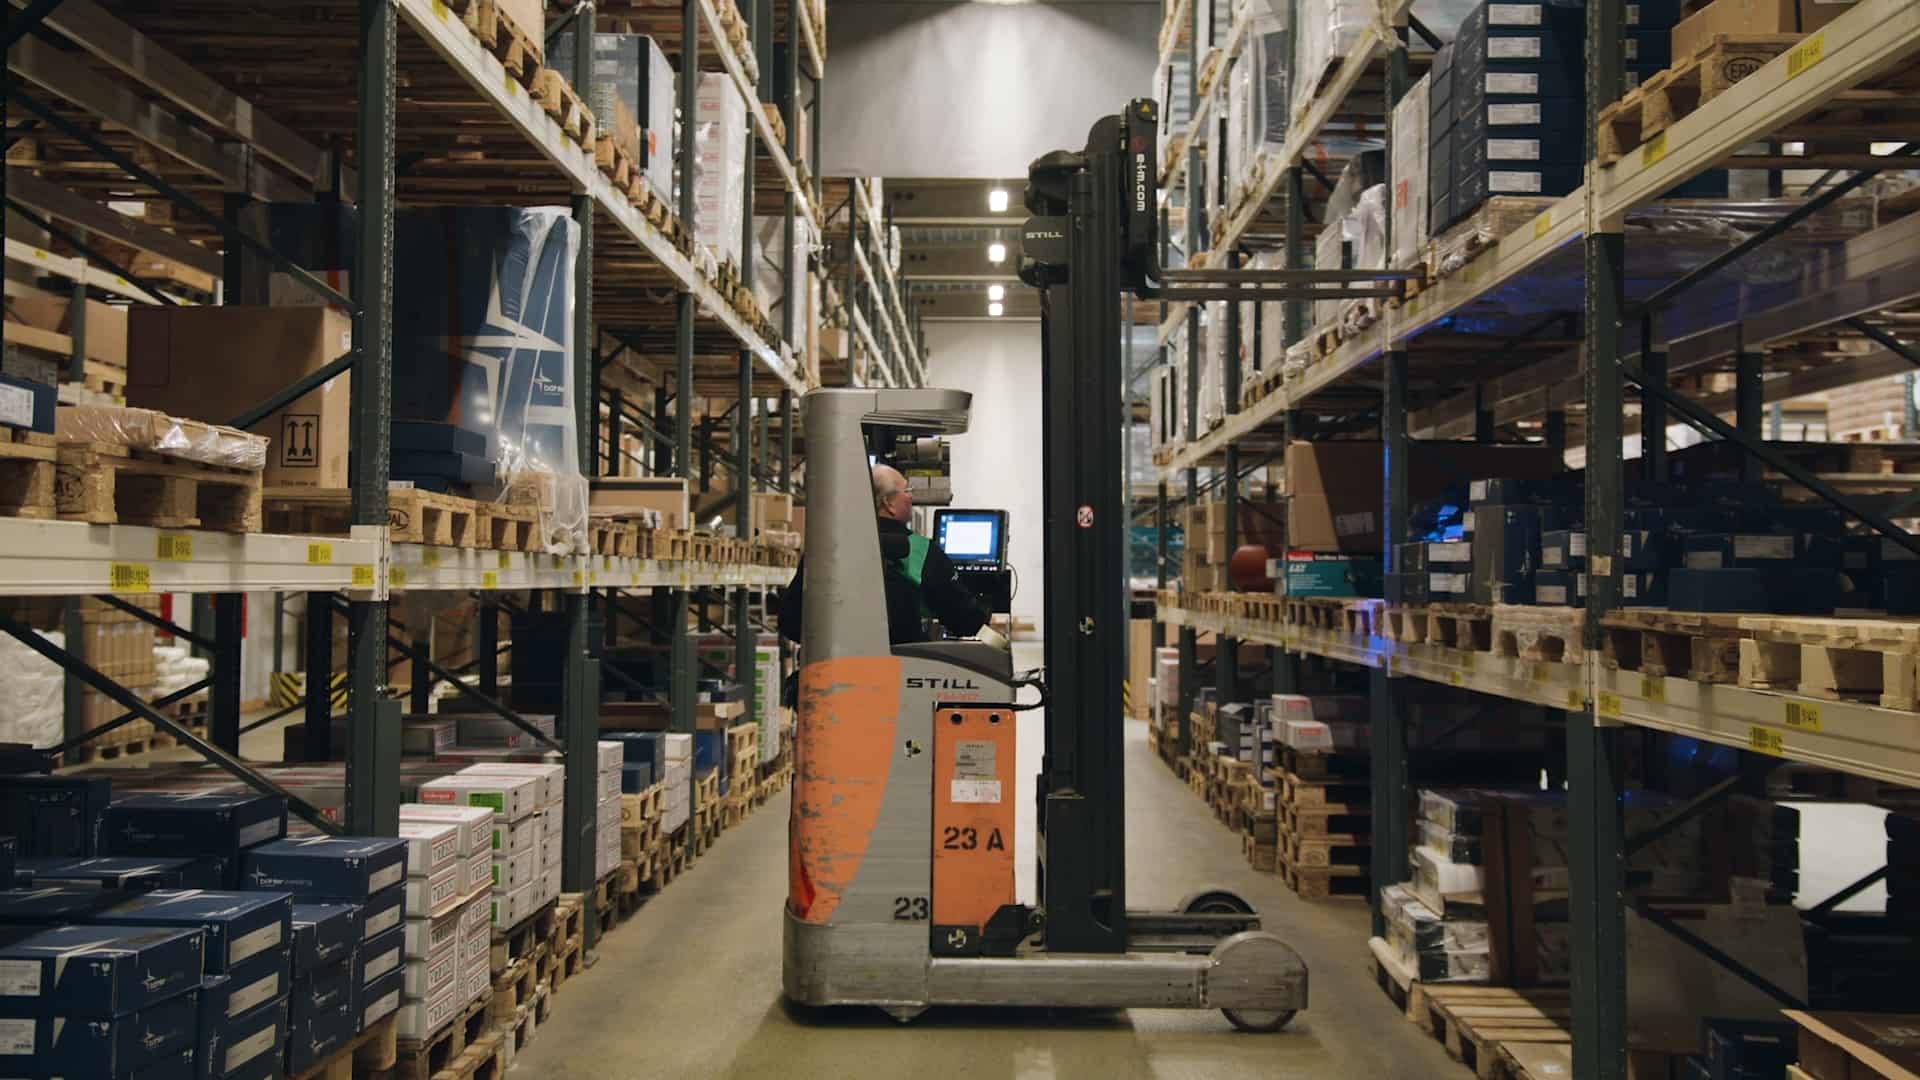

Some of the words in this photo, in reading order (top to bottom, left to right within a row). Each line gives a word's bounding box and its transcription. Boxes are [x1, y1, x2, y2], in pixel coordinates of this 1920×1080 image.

[1025, 231, 1064, 240] STILL
[906, 677, 979, 690] STILL
[943, 826, 978, 850] 23
[986, 827, 1005, 851] A
[894, 896, 929, 921] 23
